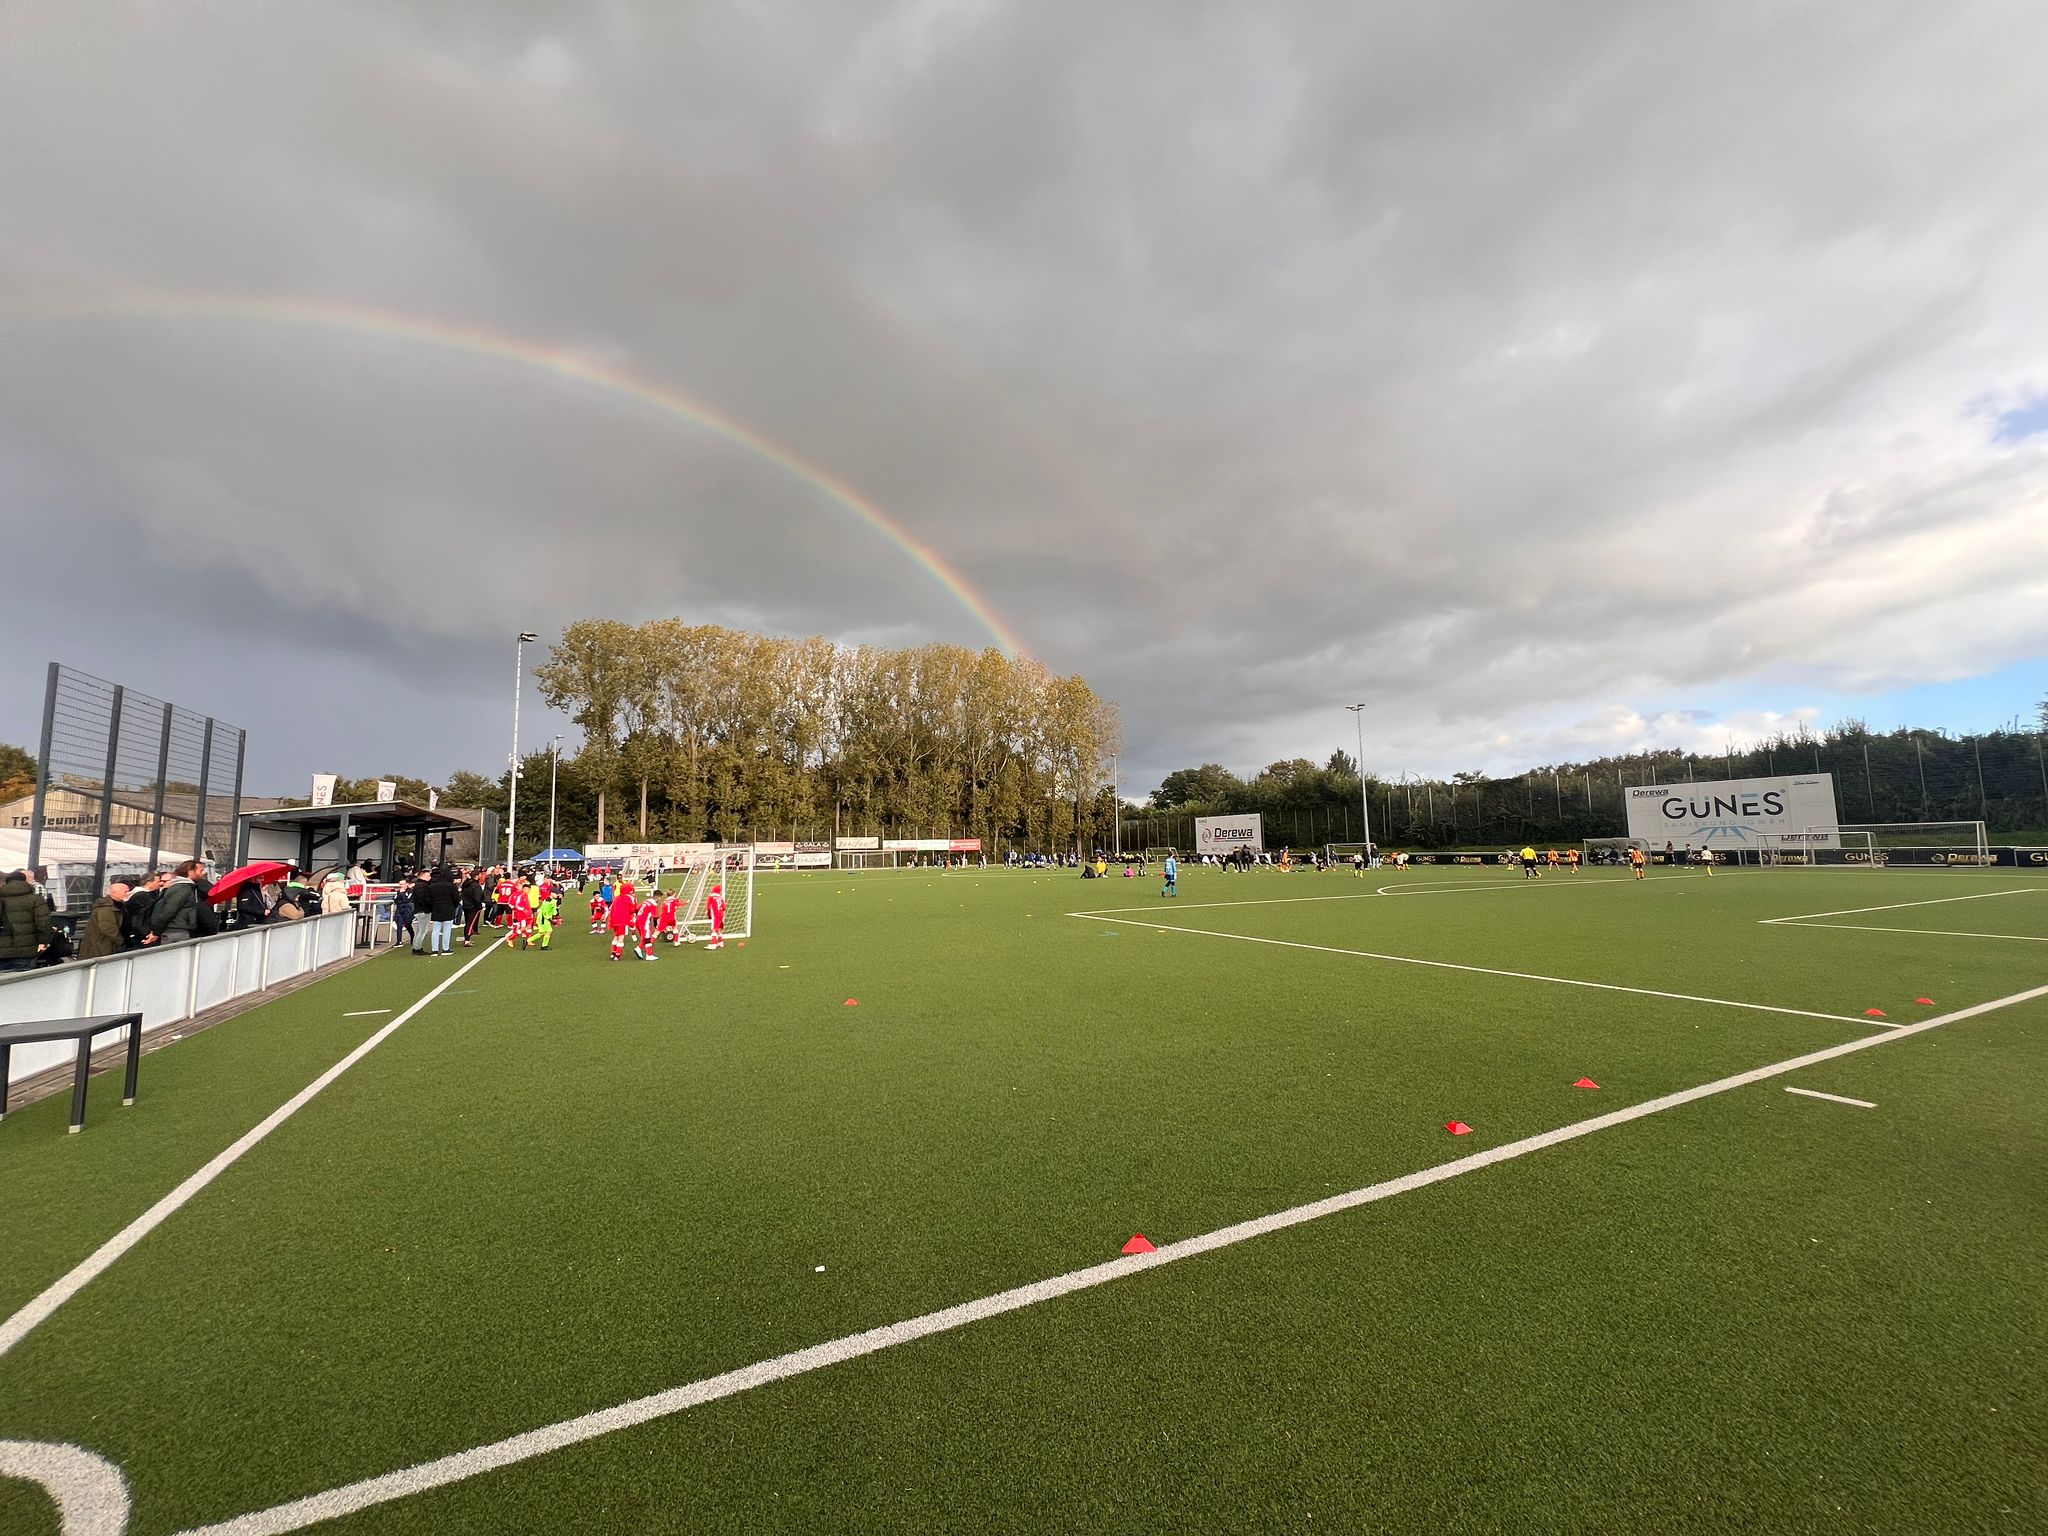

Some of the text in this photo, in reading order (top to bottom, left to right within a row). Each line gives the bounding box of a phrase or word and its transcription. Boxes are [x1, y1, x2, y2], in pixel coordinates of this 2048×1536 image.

[1632, 789, 1669, 797] Derewa
[1214, 828, 1253, 838] Derewa
[501, 887, 512, 896] 16
